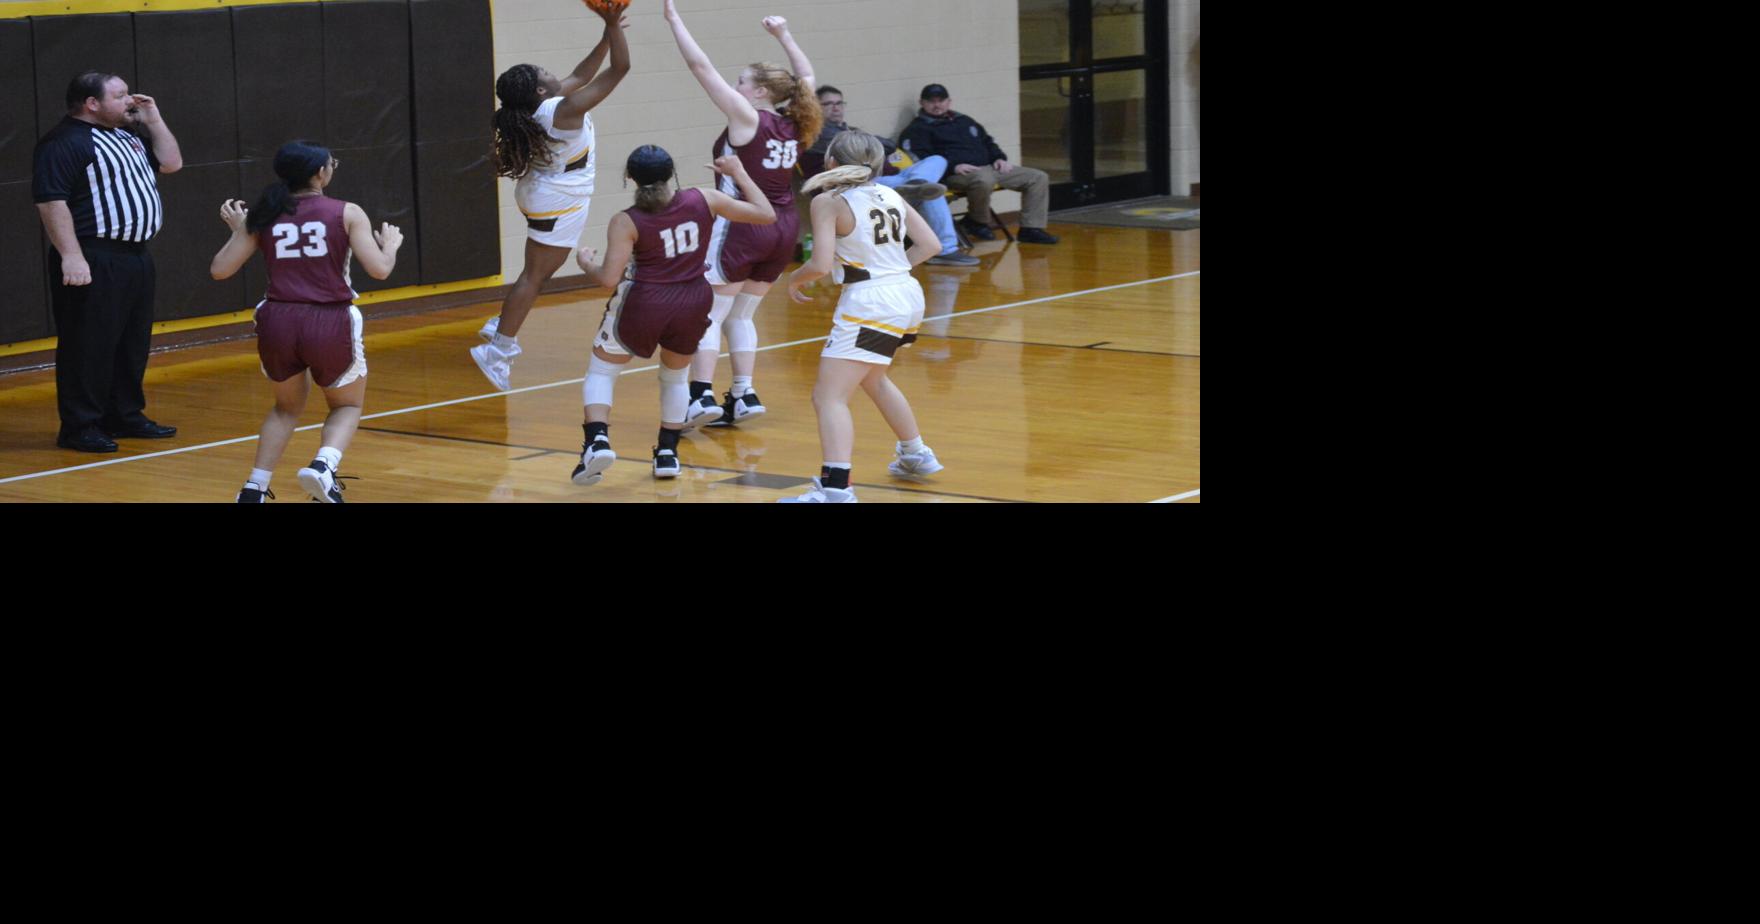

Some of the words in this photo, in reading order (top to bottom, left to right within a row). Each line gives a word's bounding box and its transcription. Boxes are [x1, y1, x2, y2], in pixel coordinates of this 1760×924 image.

[762, 139, 798, 169] 30
[272, 221, 328, 259] 23
[659, 221, 699, 258] 10
[869, 207, 901, 245] 20
